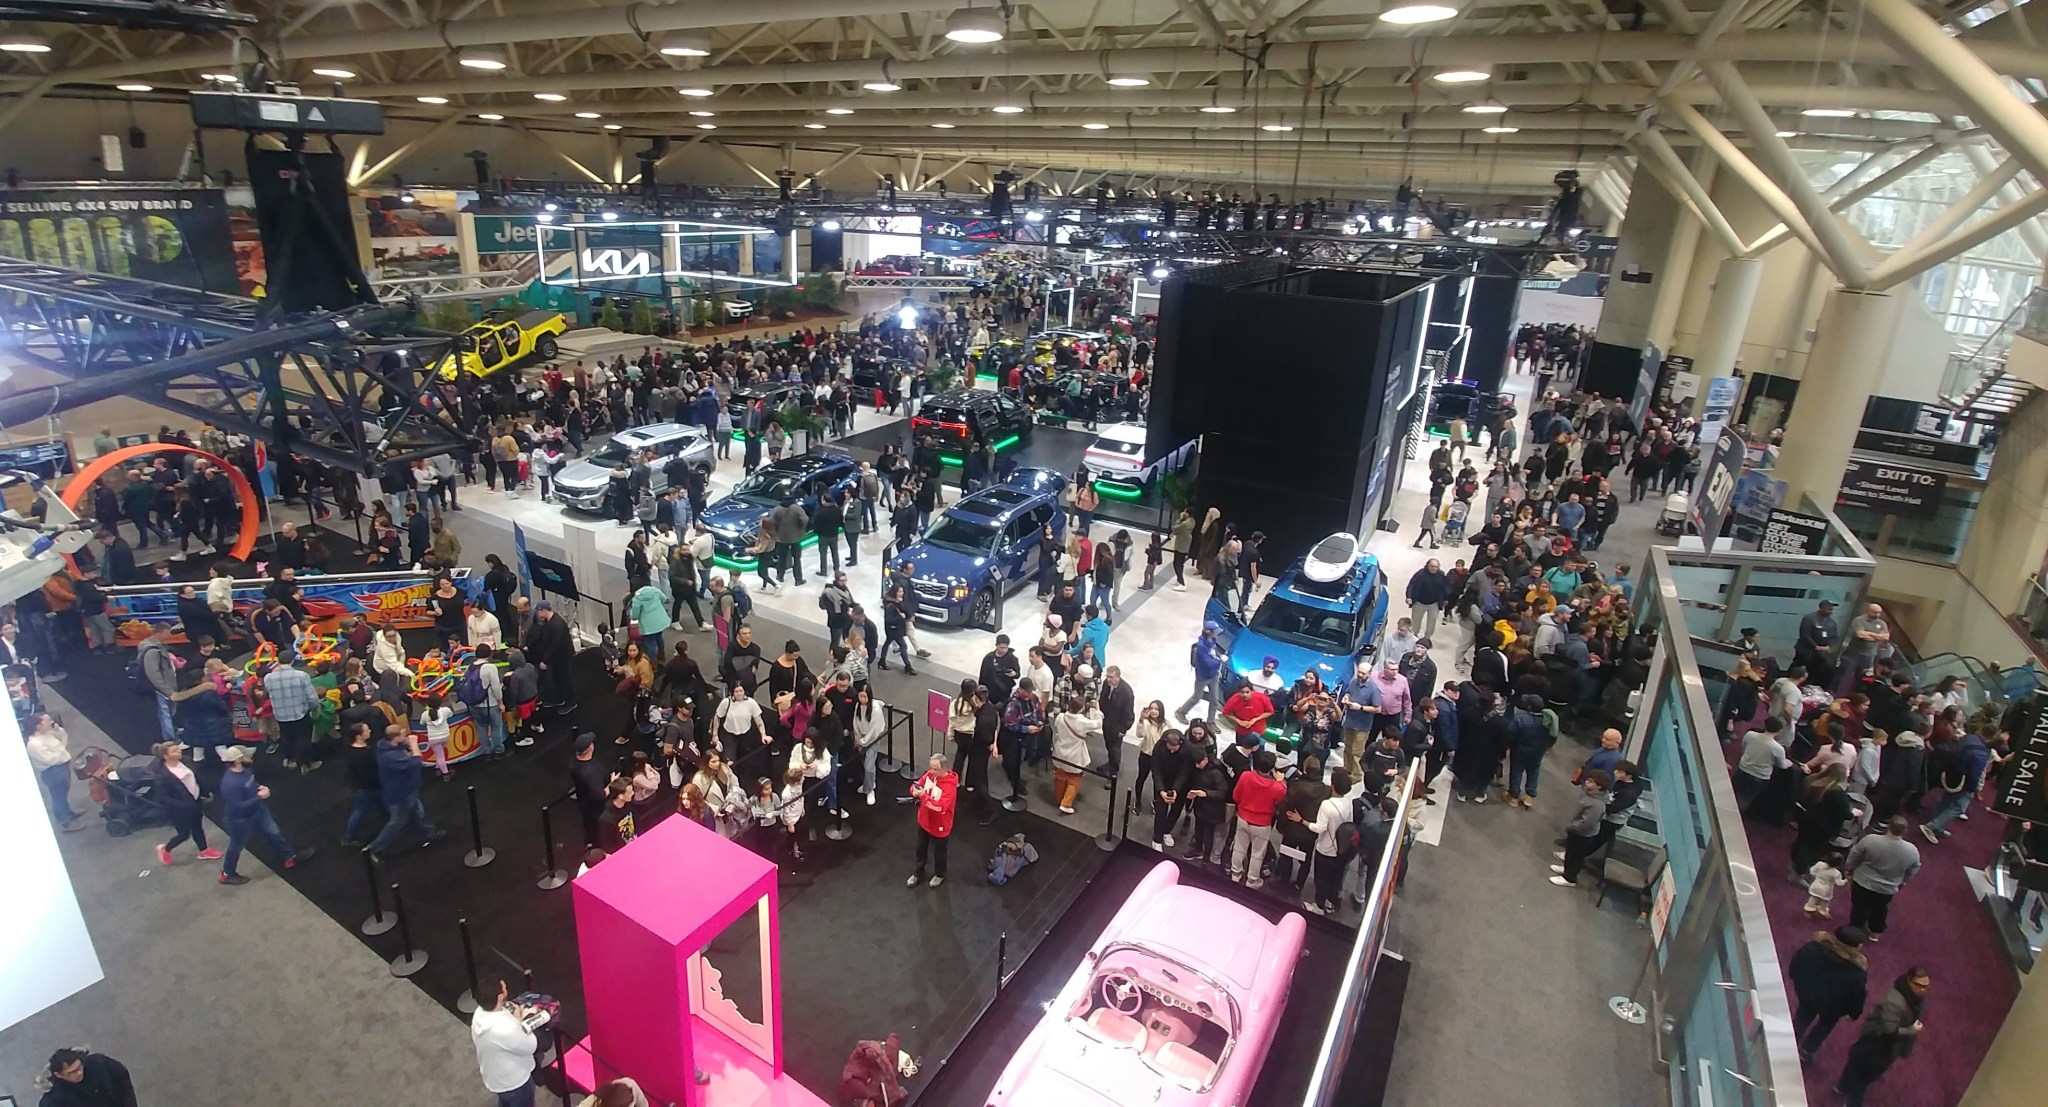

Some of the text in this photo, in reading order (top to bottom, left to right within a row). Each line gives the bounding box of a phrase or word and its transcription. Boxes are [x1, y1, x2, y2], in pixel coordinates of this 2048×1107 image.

[6, 202, 72, 213] SELLING
[75, 201, 107, 211] 4X4
[109, 200, 139, 210] SUV
[494, 221, 554, 244] Jeep
[1876, 468, 1937, 486] EXIT TO:
[1707, 462, 1734, 515] EXIT
[1887, 484, 1909, 494] Level
[1868, 490, 1878, 498] to
[1879, 492, 1904, 503] South
[1905, 496, 1922, 505] Hall
[1768, 522, 1792, 532] GET
[1765, 534, 1803, 548] TO THE
[1766, 528, 1808, 543] CLOSER
[1762, 541, 1806, 555] STORIES
[2005, 758, 2039, 807] SALLE
